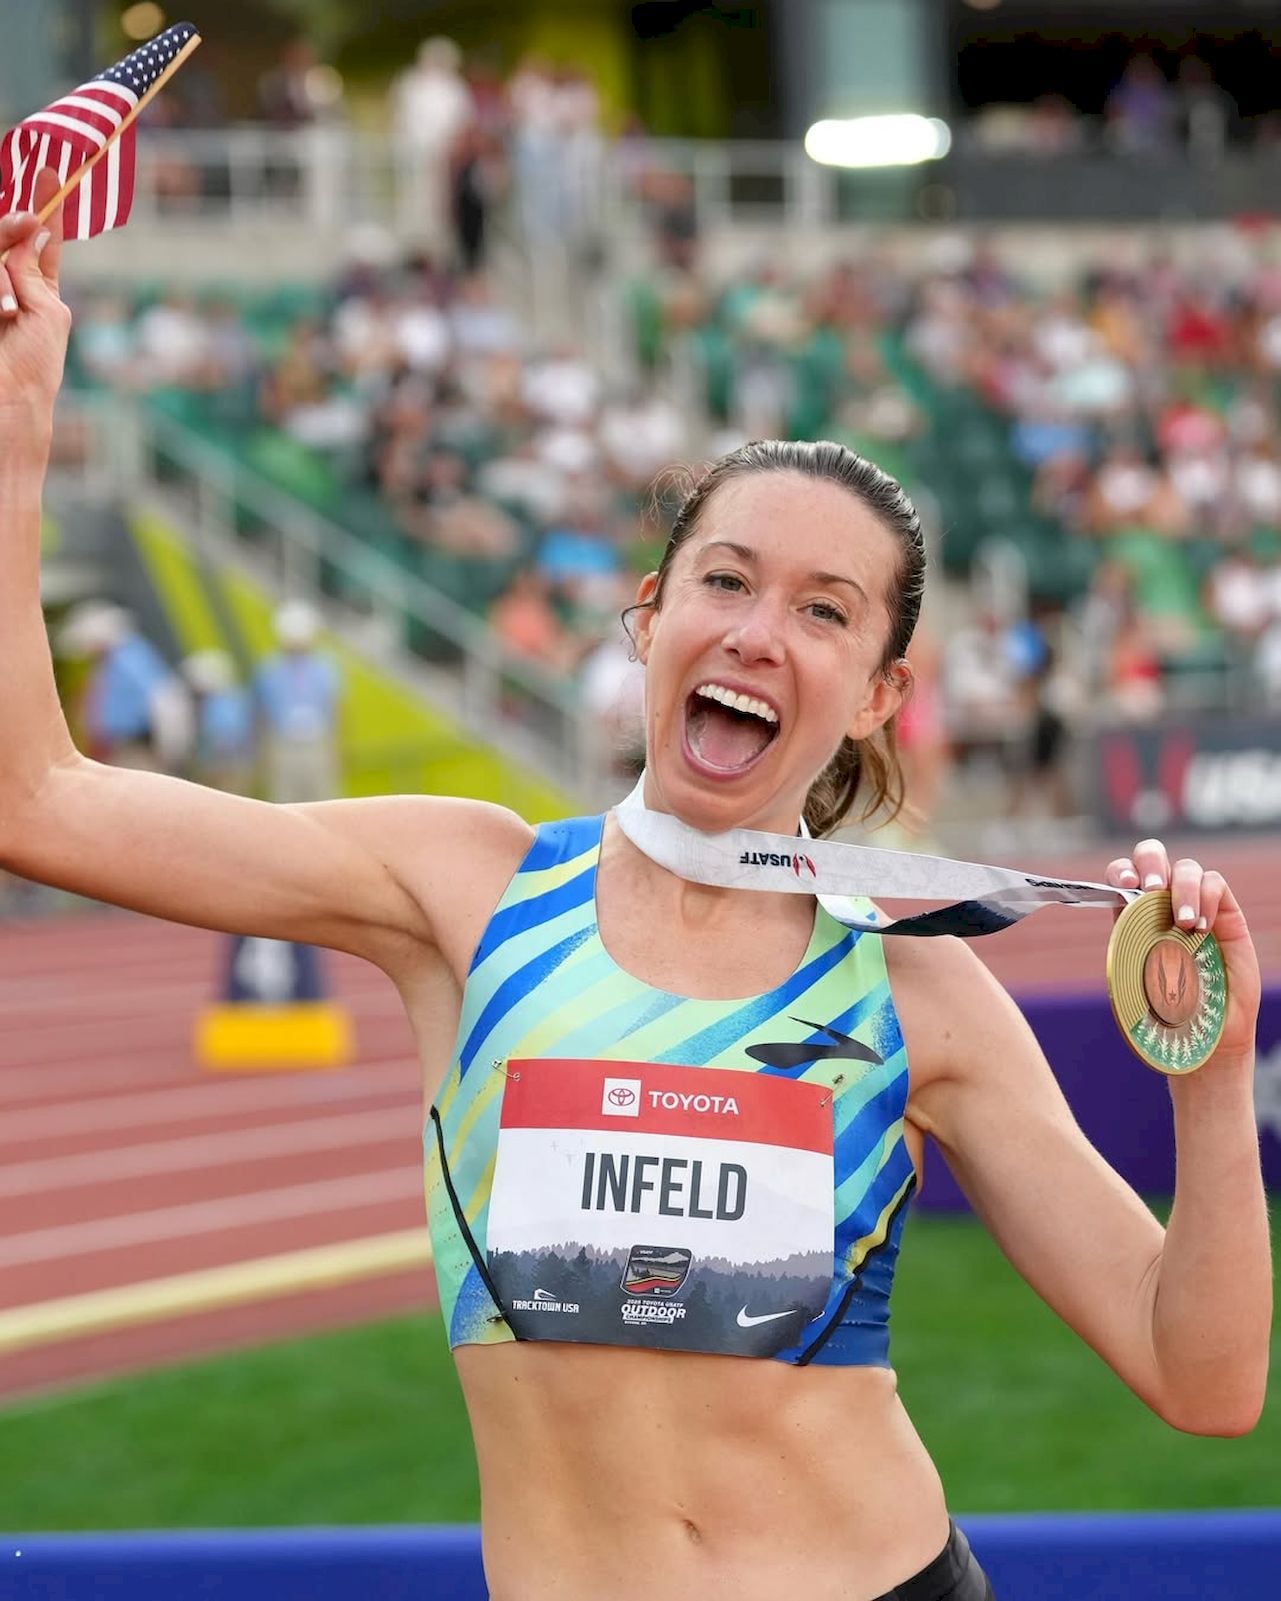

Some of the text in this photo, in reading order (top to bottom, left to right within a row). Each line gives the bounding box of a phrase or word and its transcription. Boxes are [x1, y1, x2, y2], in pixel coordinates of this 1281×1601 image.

[740, 852, 791, 867] USATF
[649, 1091, 739, 1115] TOYOTA
[581, 1152, 748, 1221] INFELD
[512, 1300, 579, 1313] TRACKTOWN USA
[621, 1304, 686, 1319] OUTDOOR
